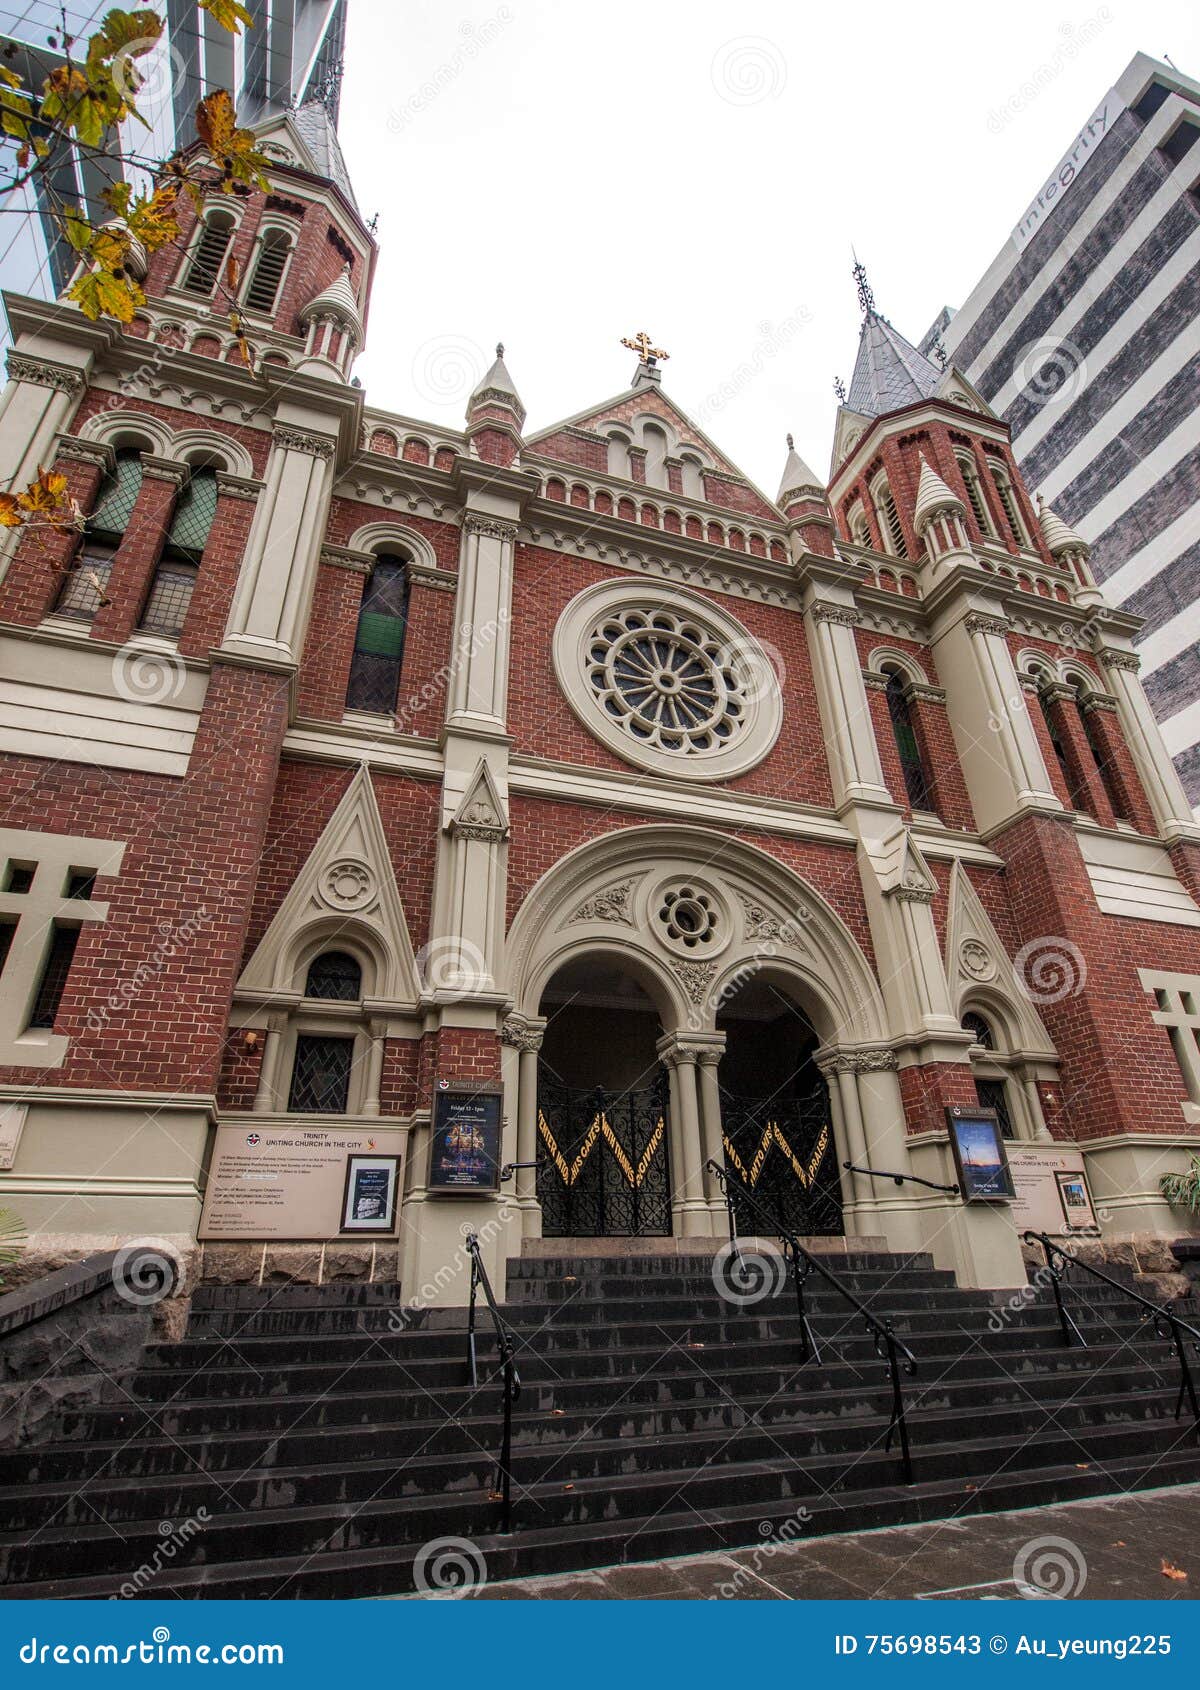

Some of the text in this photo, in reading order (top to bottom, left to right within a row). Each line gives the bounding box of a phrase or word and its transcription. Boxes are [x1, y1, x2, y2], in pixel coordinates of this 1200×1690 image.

[1018, 105, 1107, 237] integrity
[266, 1139, 294, 1147] UNITING
[294, 1140, 323, 1148] CHURCH
[333, 1141, 346, 1149] THE
[303, 1132, 329, 1140] TRINITY
[571, 1121, 600, 1180] HIS GATES
[638, 1125, 664, 1174] GIVING
[723, 1136, 741, 1169] AND
[809, 1135, 828, 1178] PRAISE
